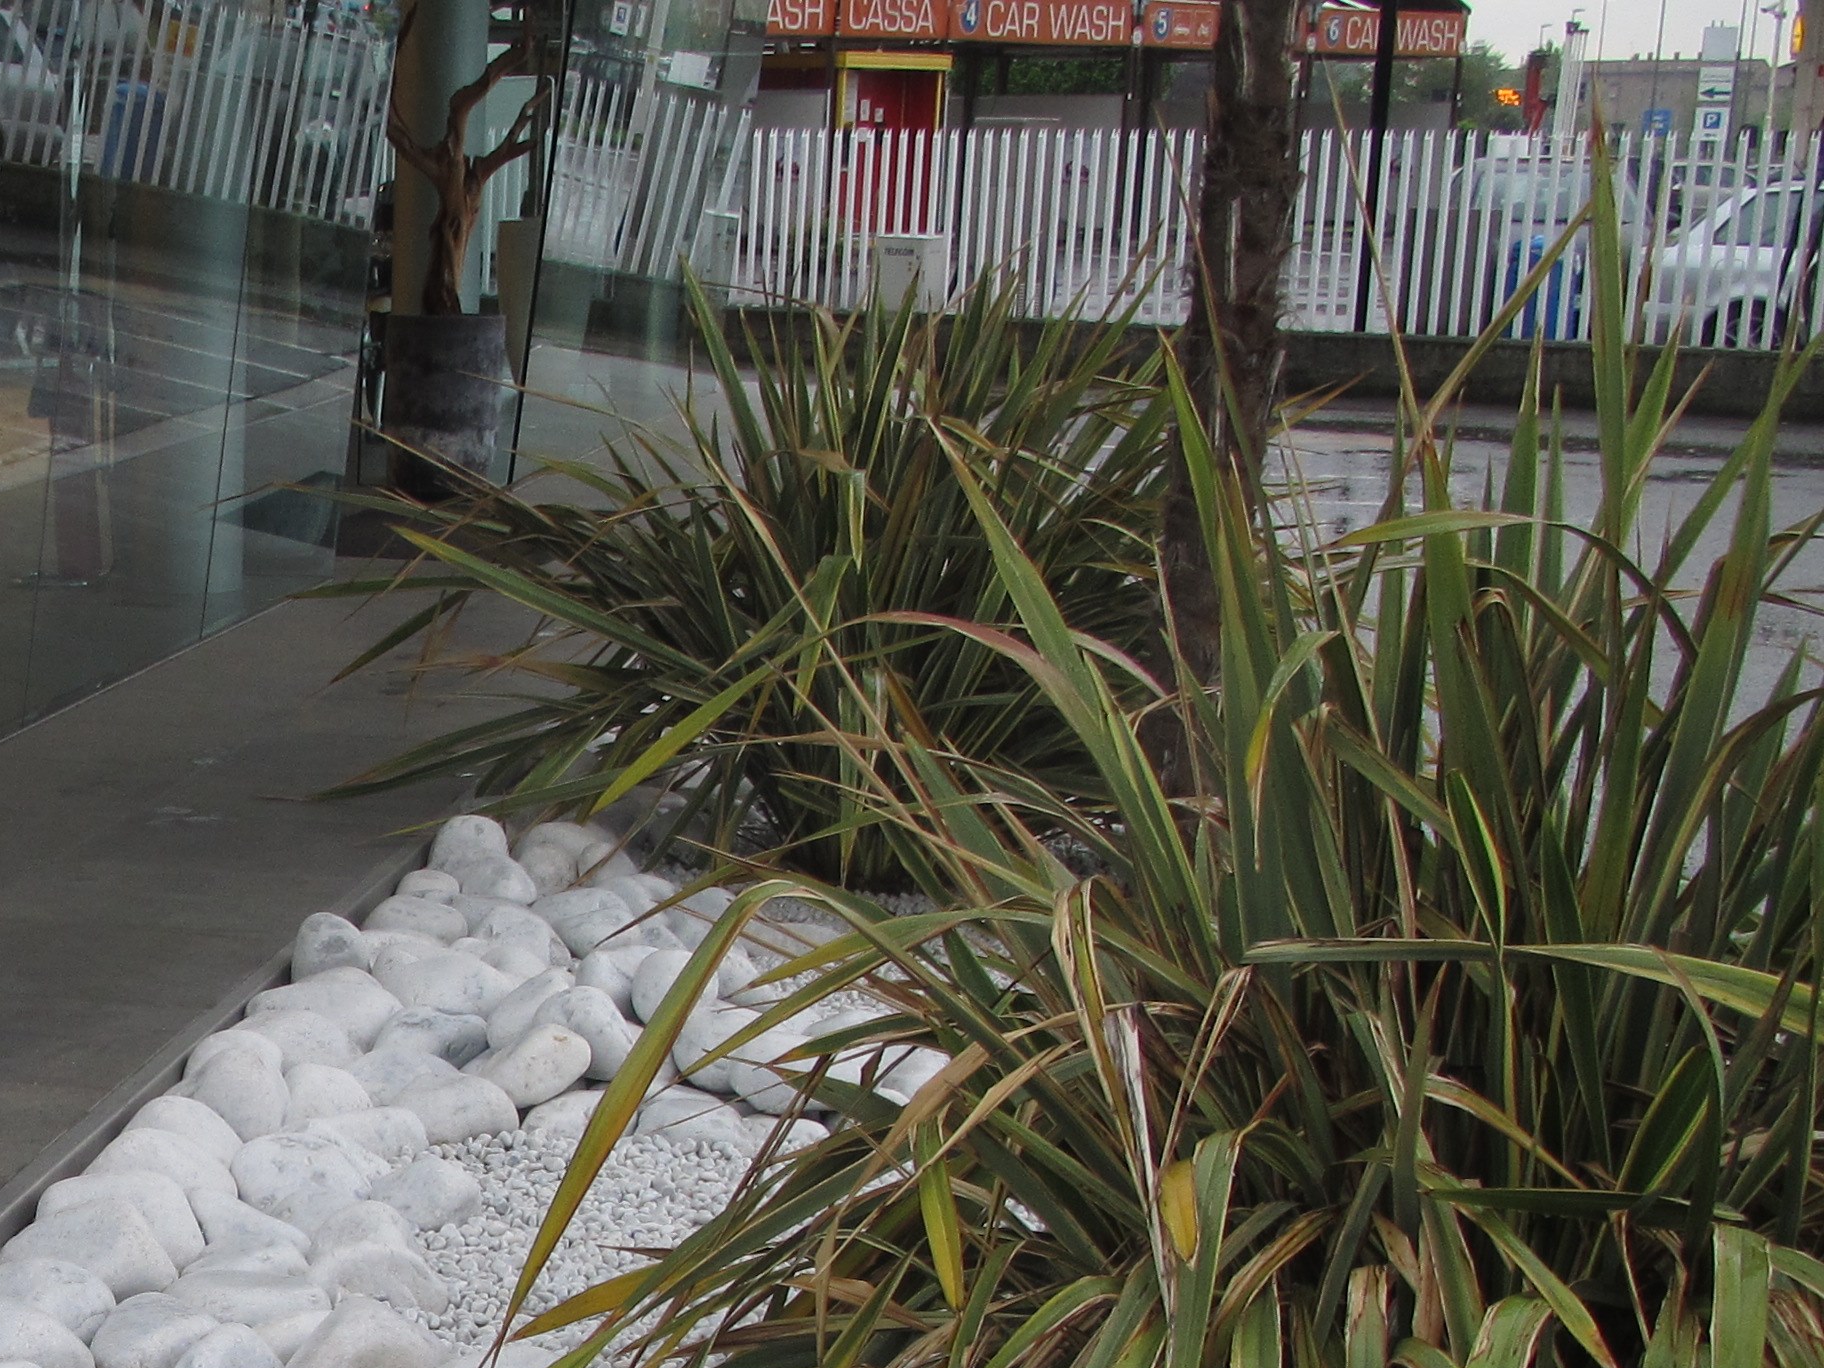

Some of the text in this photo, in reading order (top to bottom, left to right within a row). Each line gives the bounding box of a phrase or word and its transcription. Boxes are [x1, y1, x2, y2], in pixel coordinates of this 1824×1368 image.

[766, 0, 824, 30] ASH
[849, 0, 934, 33] CASSA
[965, 0, 1125, 41] 4 CAR WASH
[1158, 11, 1168, 35] 5
[1329, 18, 1340, 40] 6
[1396, 18, 1459, 51] WASH
